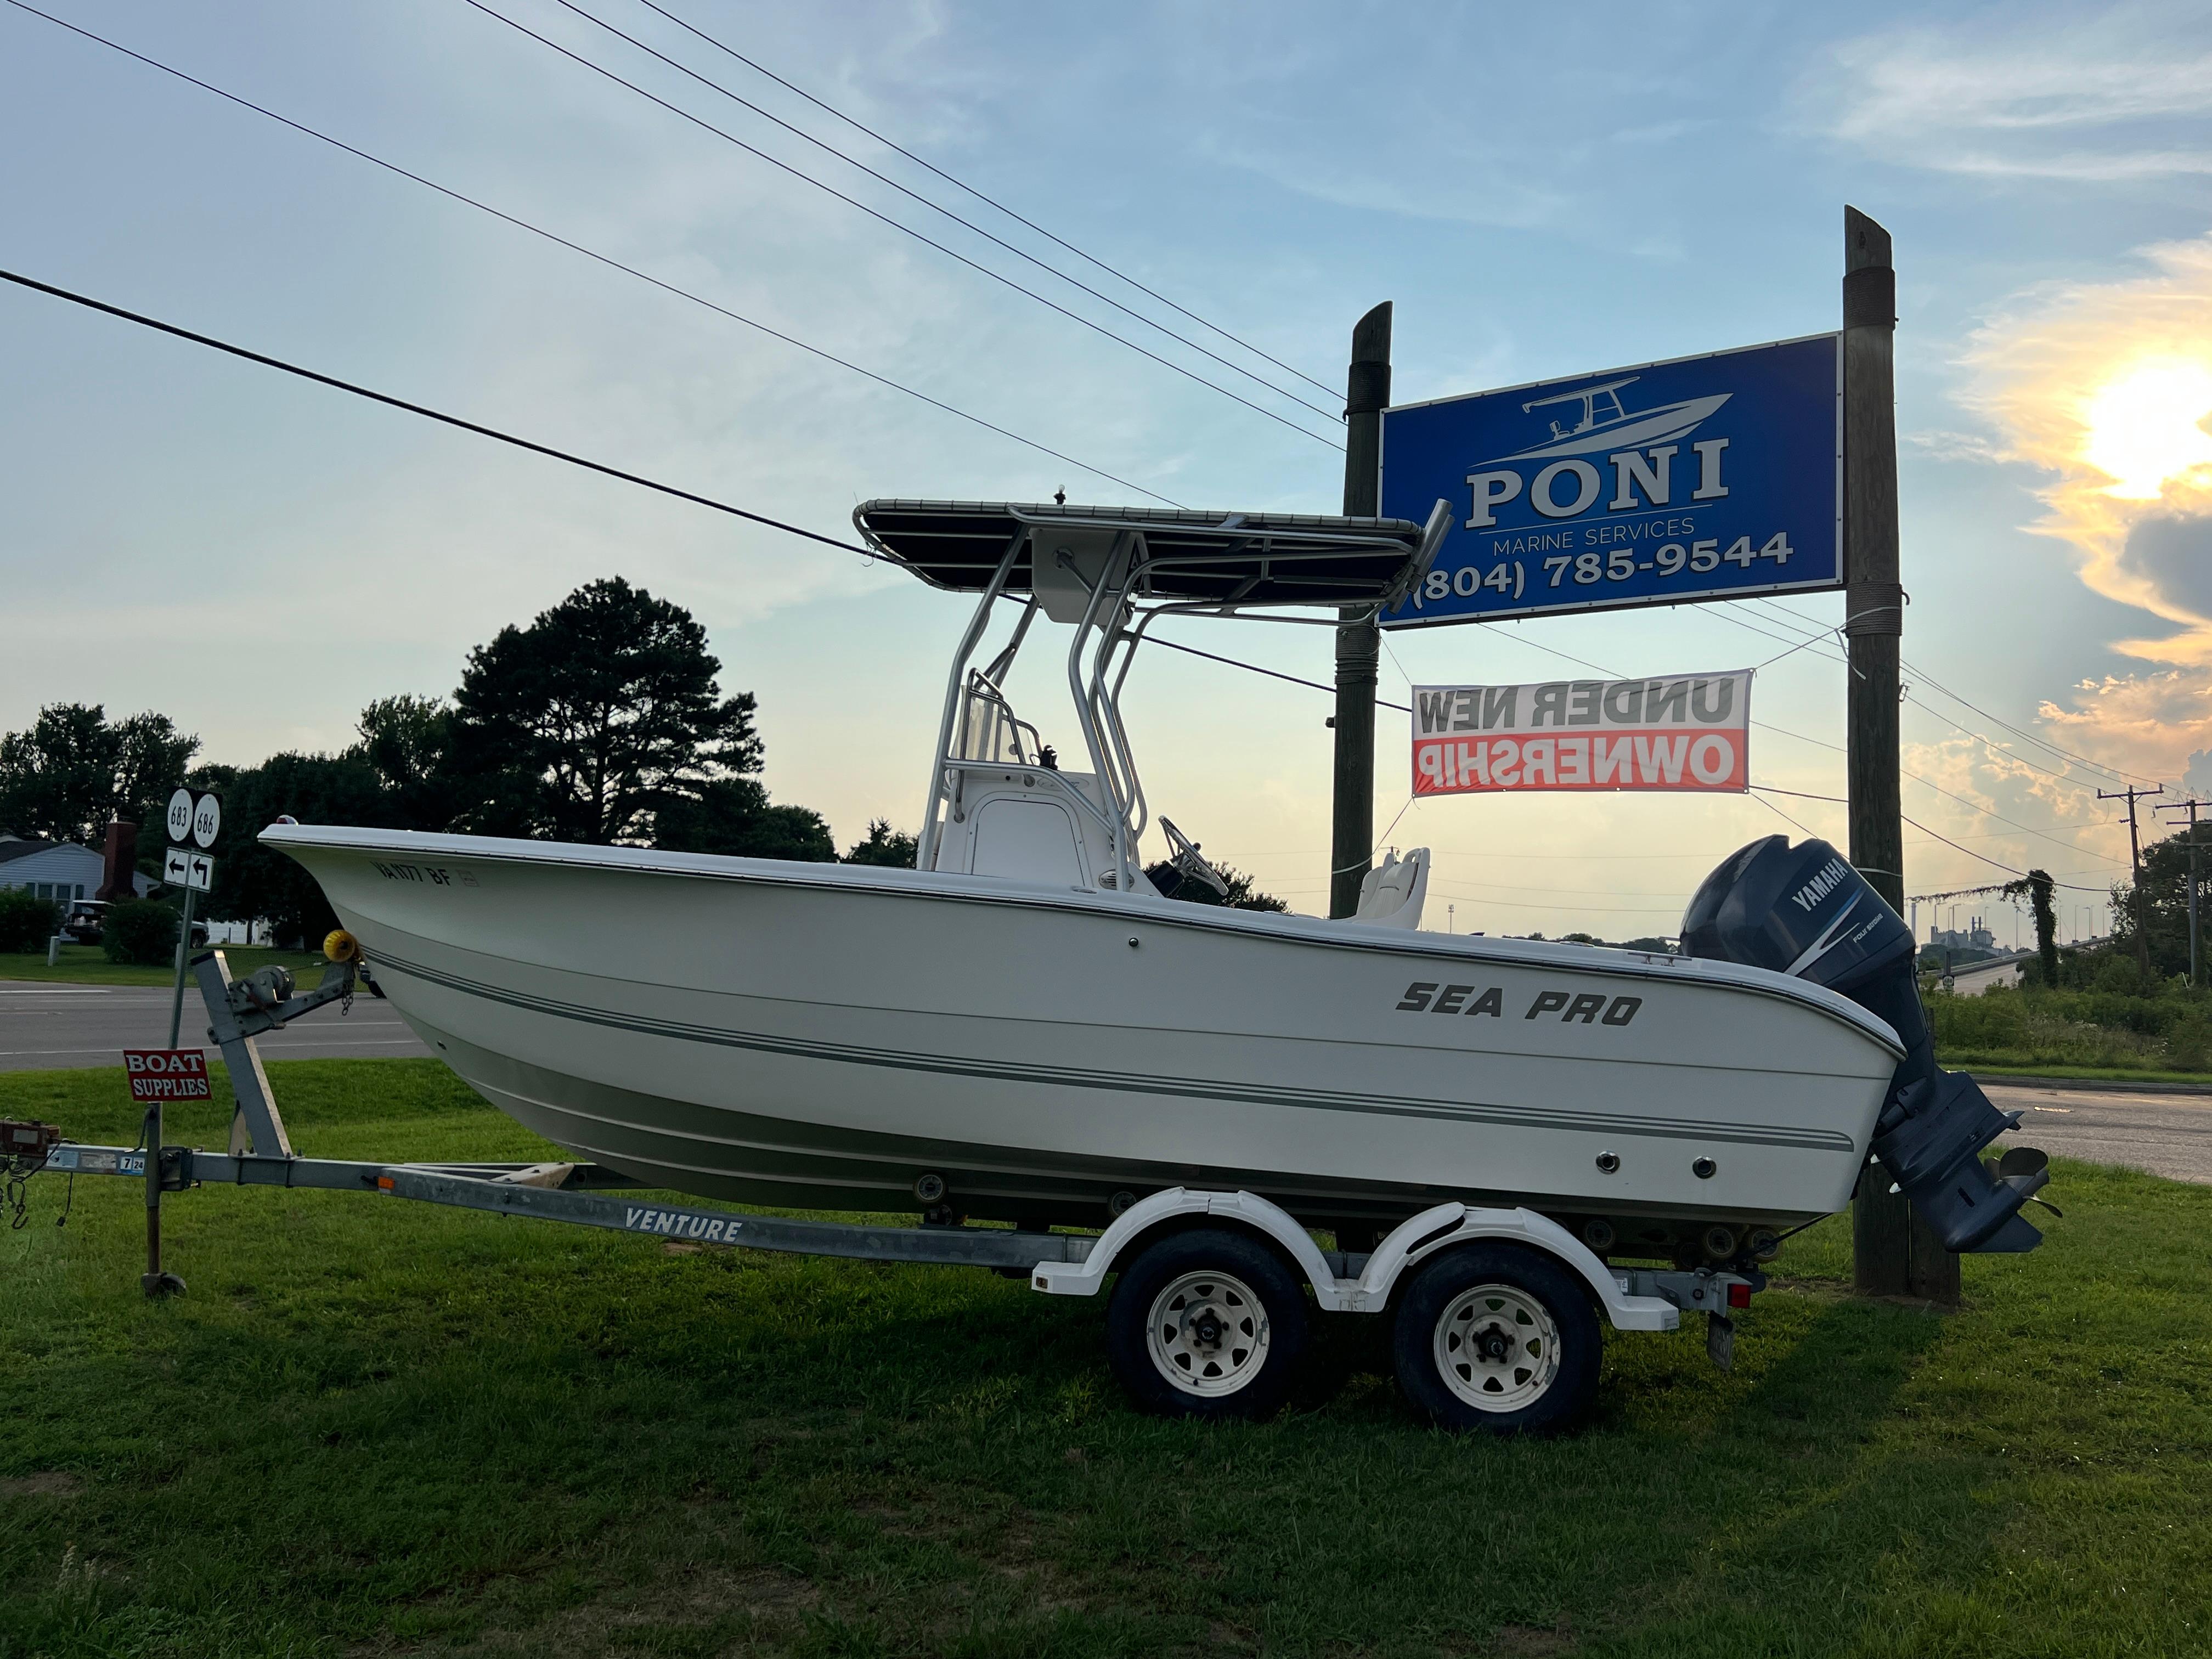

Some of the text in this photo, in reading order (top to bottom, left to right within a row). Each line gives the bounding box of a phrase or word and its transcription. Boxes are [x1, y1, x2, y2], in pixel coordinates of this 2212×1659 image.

[1465, 438, 1730, 529] PONI
[1493, 517, 1695, 556] MARINE SERVICES
[1543, 532, 1794, 588] 785-9544
[171, 805, 187, 827] 683
[198, 812, 214, 834] 686
[424, 867, 450, 886] BF
[1791, 857, 1848, 912] YAMAHA
[1395, 982, 1643, 1026] SEA PRO
[126, 1054, 203, 1073] BOAT
[133, 1077, 208, 1096] SUPPLIES
[125, 1158, 131, 1169] 7
[134, 1161, 143, 1169] 24
[625, 1207, 743, 1242] VENTURE
